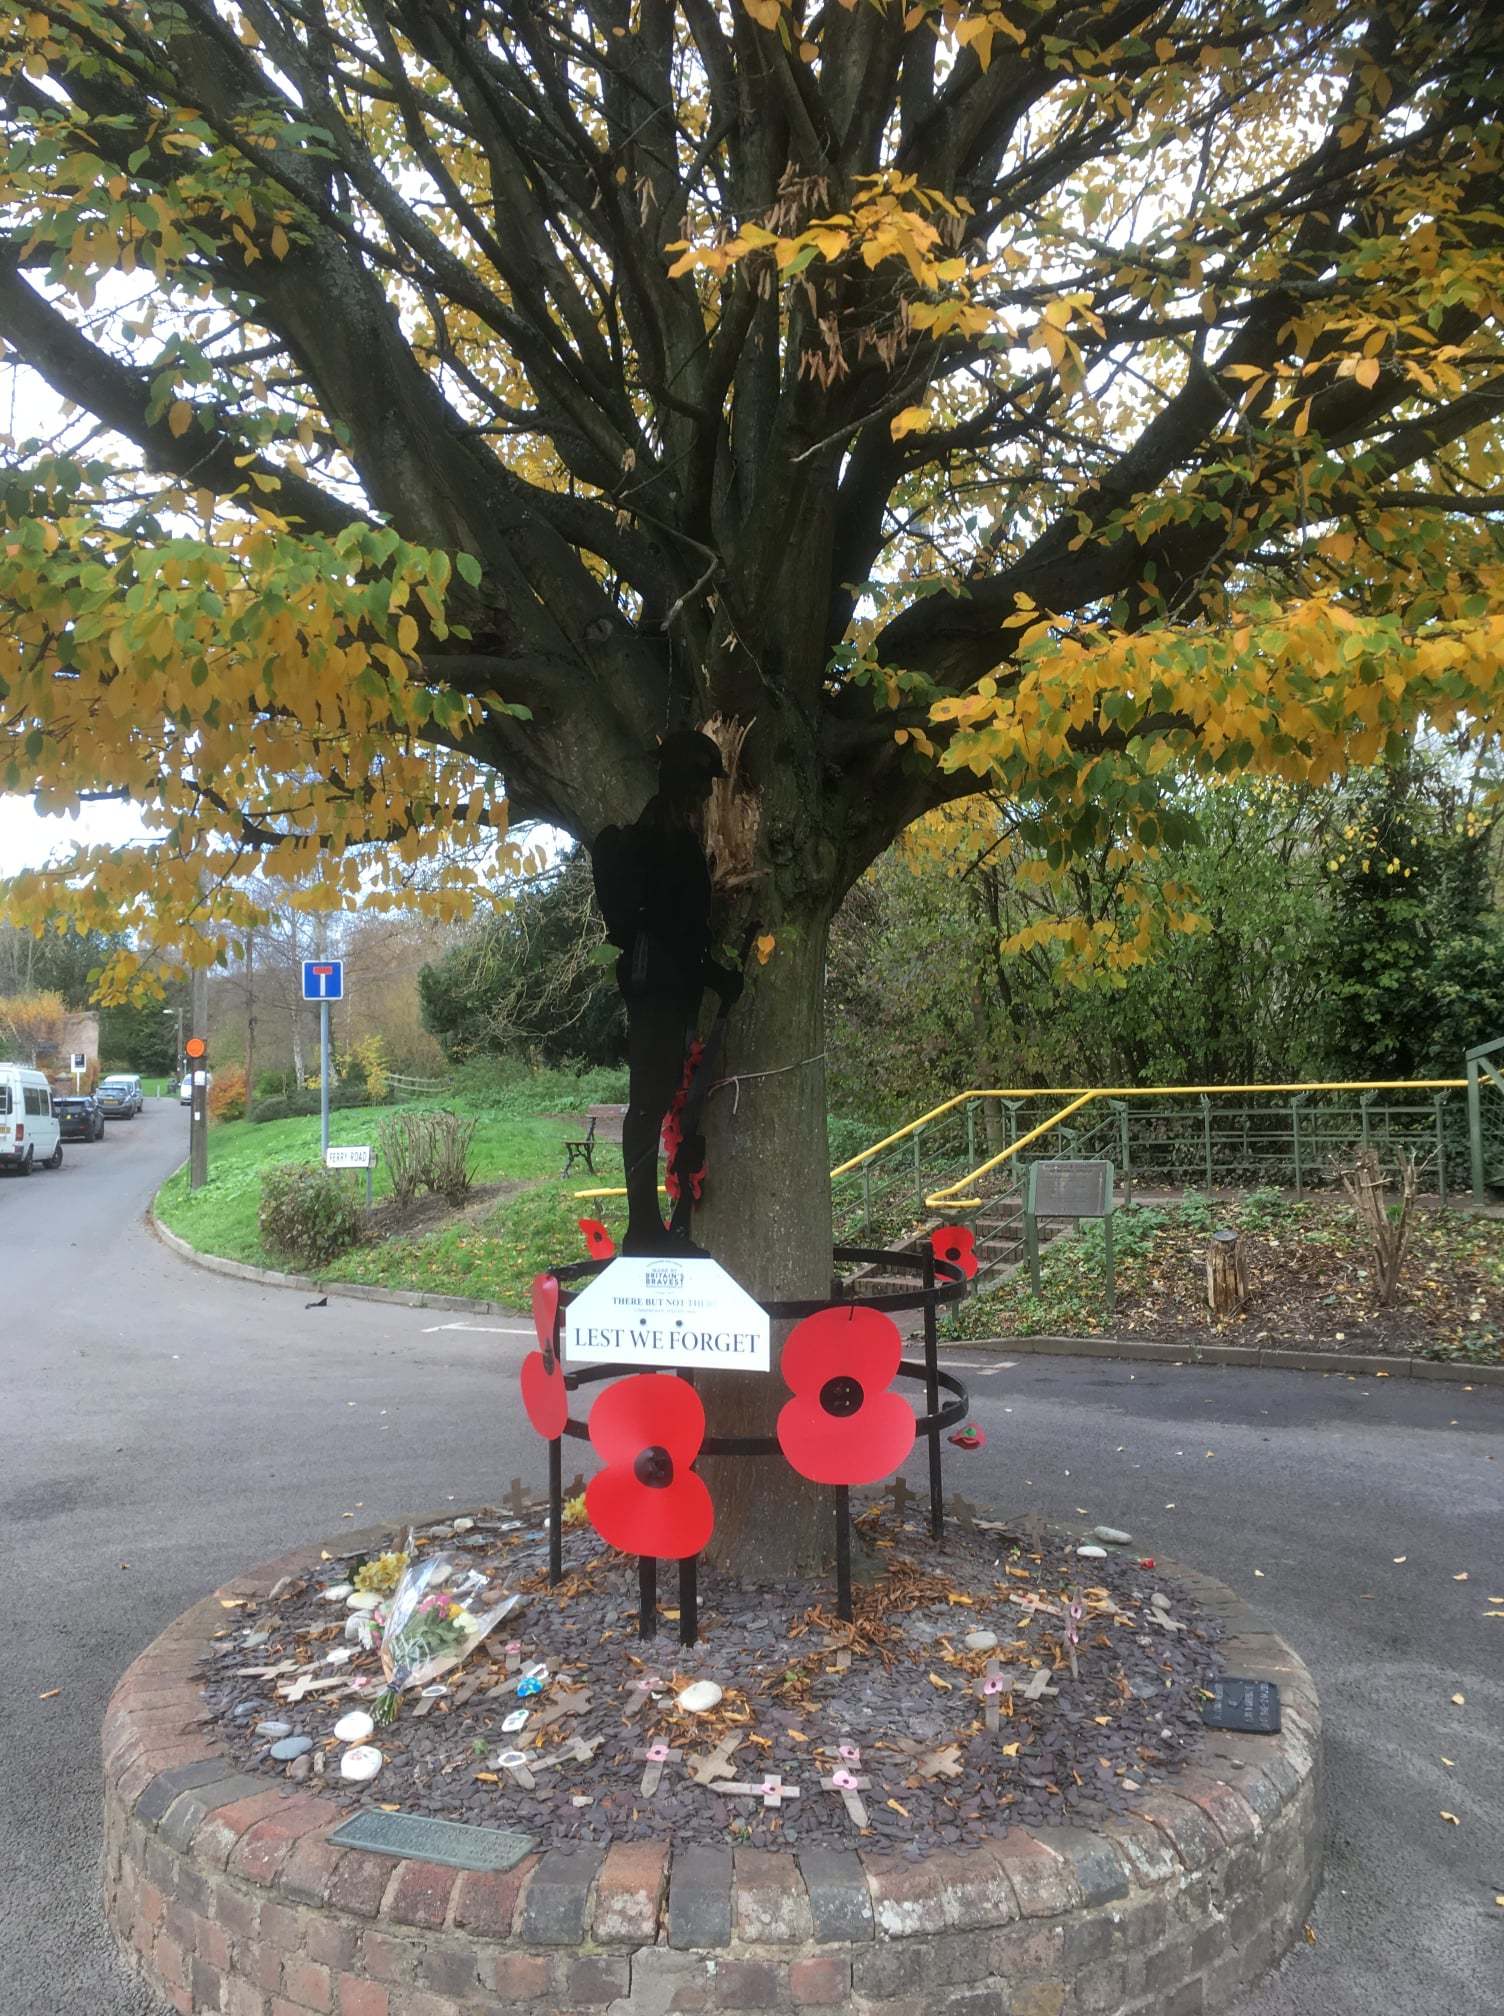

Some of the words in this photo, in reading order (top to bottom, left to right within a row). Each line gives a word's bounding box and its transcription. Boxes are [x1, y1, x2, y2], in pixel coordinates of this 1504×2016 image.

[329, 1152, 348, 1162] FERRY
[350, 1151, 367, 1162] ROAD
[612, 1296, 644, 1306] THERE
[645, 1297, 665, 1306] BUT
[666, 1298, 685, 1307] NOT
[575, 1328, 625, 1348] LEST
[630, 1330, 664, 1349] WE
[669, 1331, 761, 1353] FORGET
